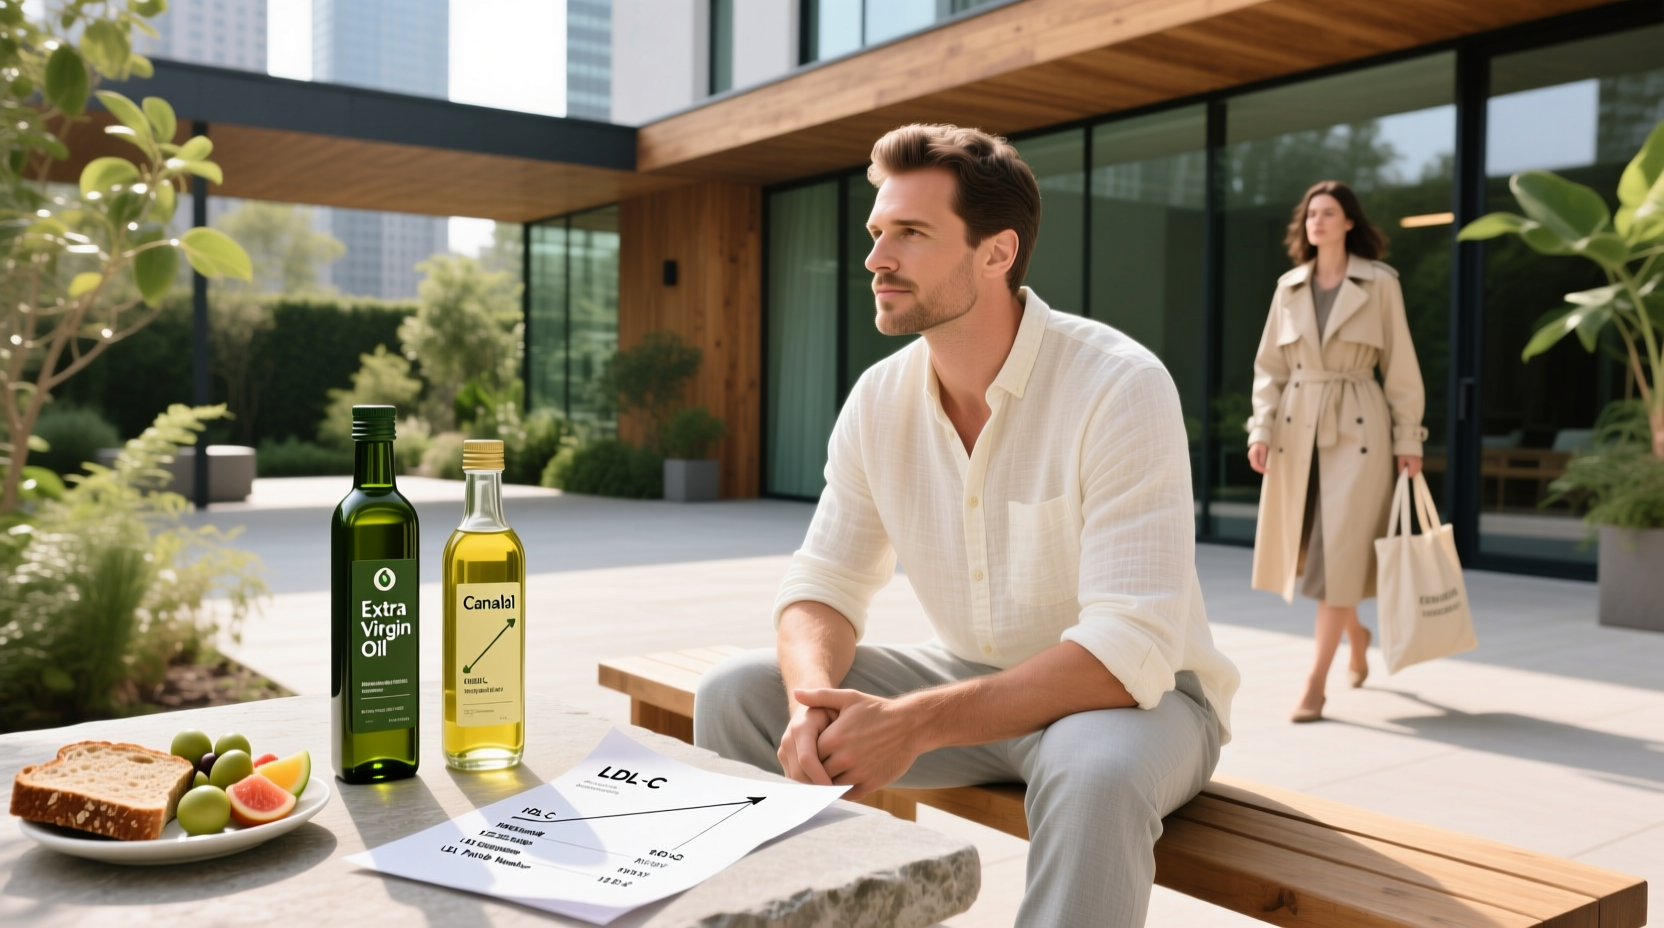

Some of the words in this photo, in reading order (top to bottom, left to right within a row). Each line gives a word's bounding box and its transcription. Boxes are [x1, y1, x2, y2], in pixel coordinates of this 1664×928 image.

[361, 600, 407, 618] Extra
[360, 619, 411, 641] Virgin
[597, 765, 668, 789] LDL-C
